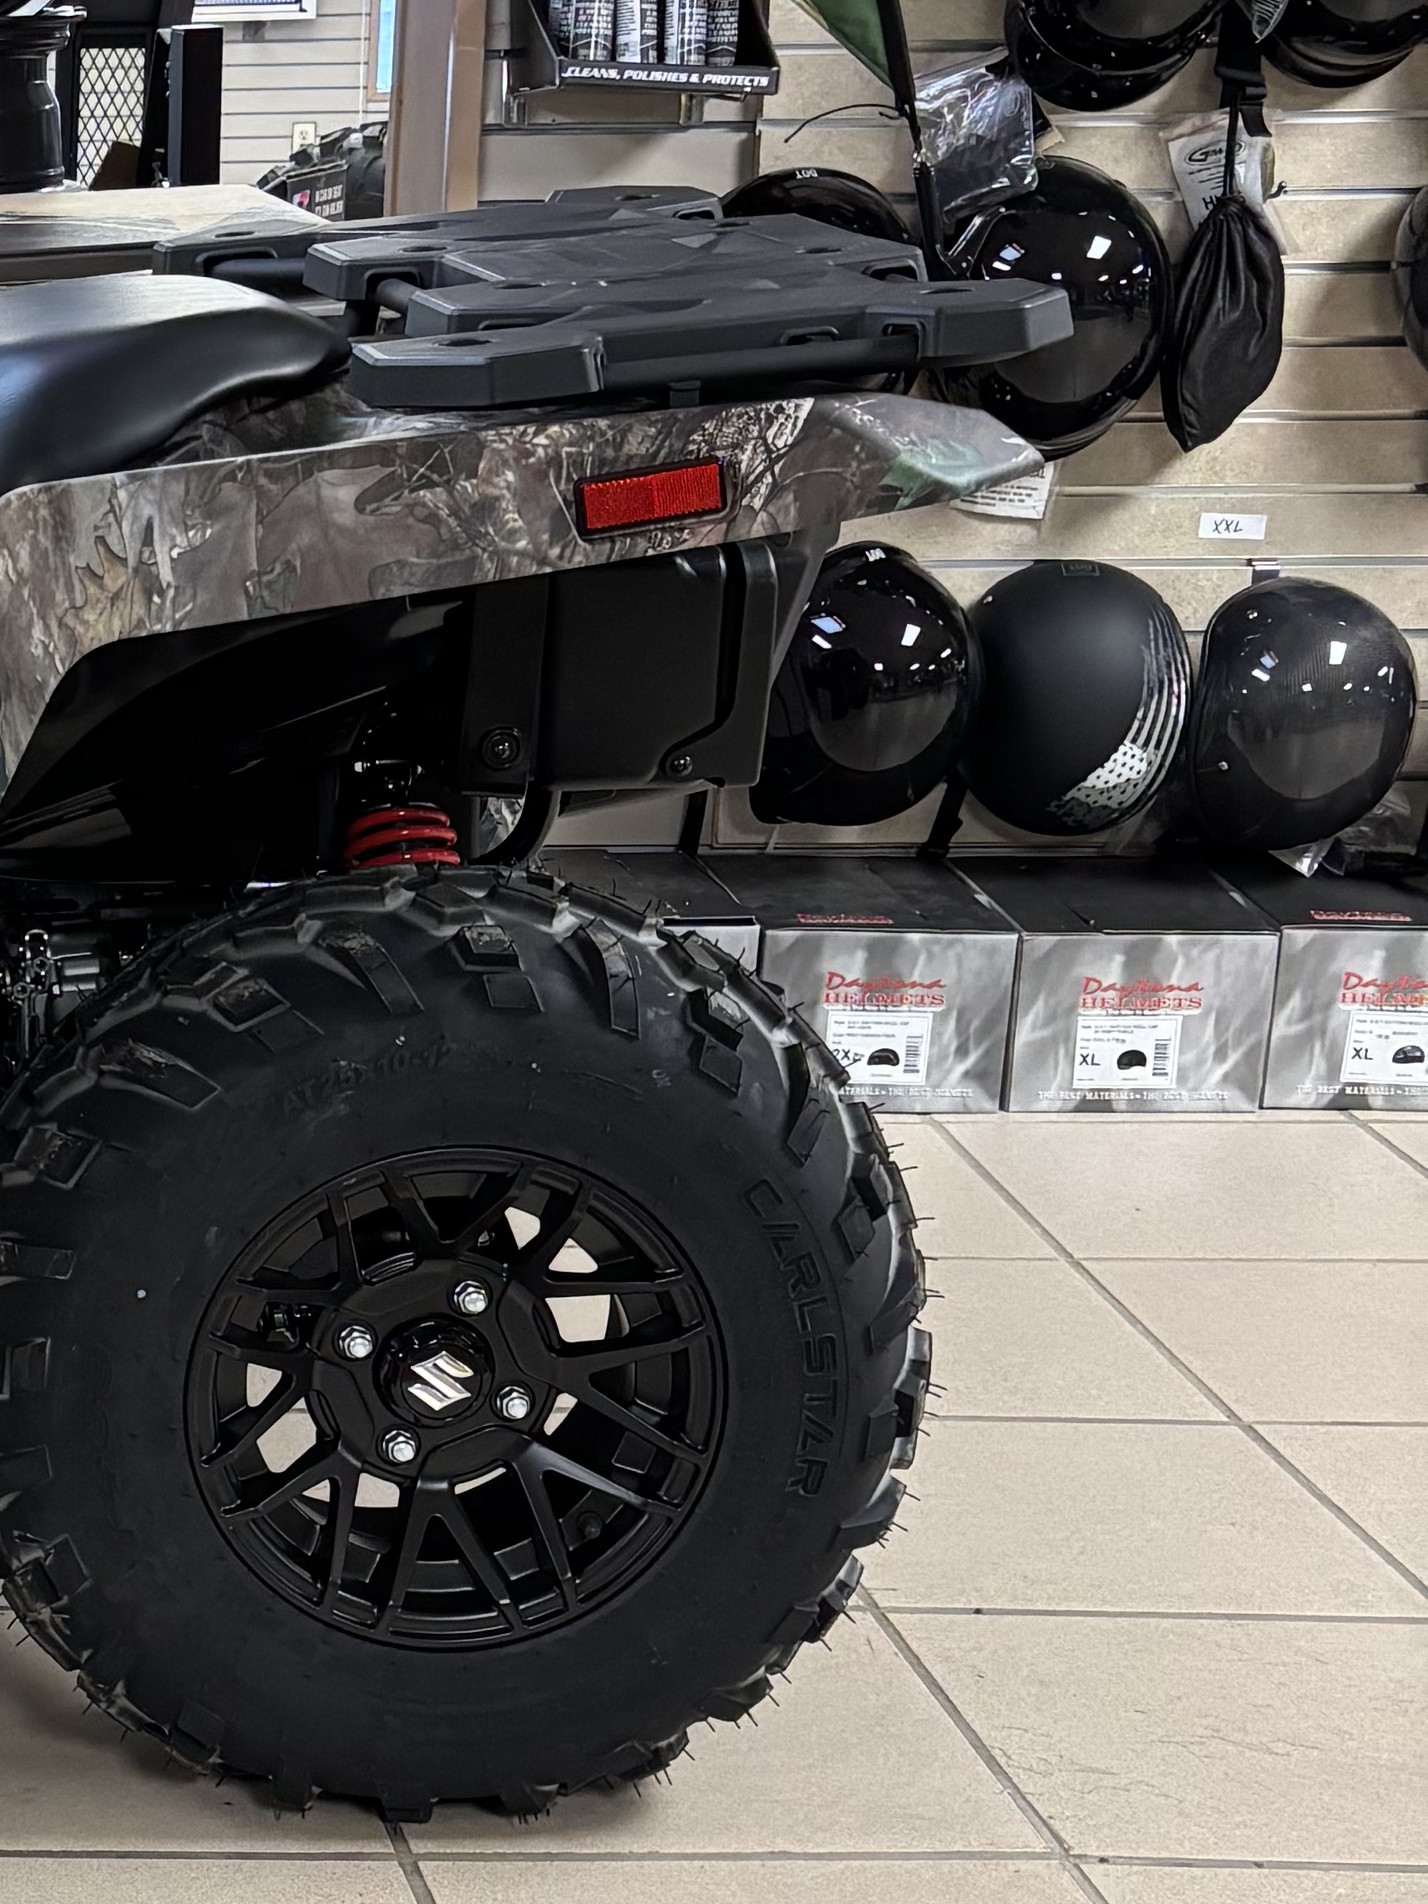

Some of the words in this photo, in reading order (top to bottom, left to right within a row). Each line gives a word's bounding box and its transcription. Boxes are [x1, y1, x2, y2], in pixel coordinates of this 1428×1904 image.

[623, 69, 688, 83] POLISHES
[703, 73, 769, 87] PROTECTS
[1212, 518, 1244, 533] XXL
[825, 971, 947, 995] Daytona
[1080, 976, 1204, 1000] Daytona
[1342, 971, 1428, 995] Dayto
[823, 992, 945, 1006] HELMETS
[1079, 997, 1203, 1010] HELMETS
[1079, 1053, 1101, 1066] XL
[1351, 1047, 1374, 1061] XL
[839, 1086, 879, 1096] ATERIALS
